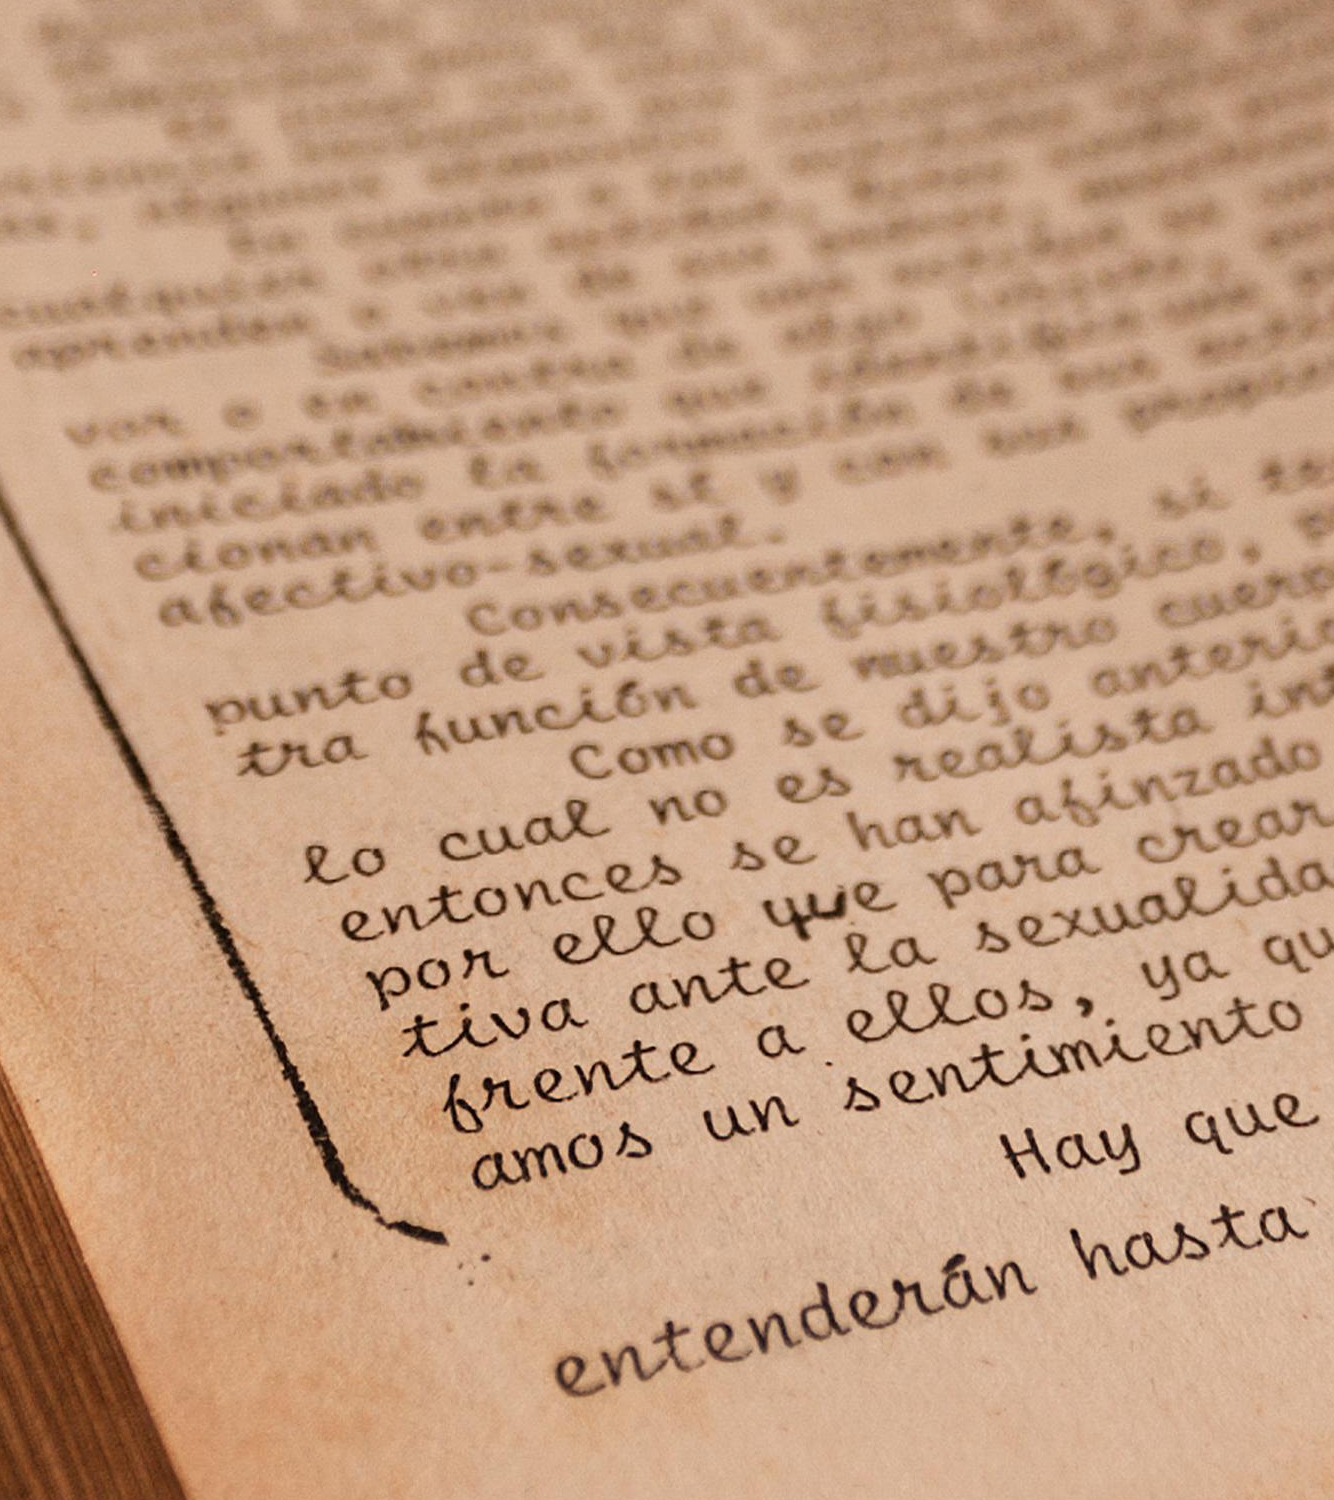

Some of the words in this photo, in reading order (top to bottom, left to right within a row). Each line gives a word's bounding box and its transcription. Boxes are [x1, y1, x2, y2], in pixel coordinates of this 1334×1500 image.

[203, 670, 413, 737] punto
[458, 648, 543, 687] de
[577, 617, 778, 669] vista
[237, 734, 368, 779] tra
[413, 680, 697, 757] función
[732, 660, 817, 699] de
[851, 619, 1116, 681] nuestro
[568, 733, 736, 781] Como
[783, 712, 863, 749] se
[899, 685, 1050, 728] dijo
[303, 843, 387, 887] lo
[437, 798, 611, 863] cual
[648, 788, 729, 827] no
[775, 766, 852, 805] es
[892, 708, 1211, 783] realista
[339, 854, 684, 944] entonces
[730, 835, 816, 873] se
[845, 809, 980, 852] han
[1014, 737, 1321, 827] afinzado
[364, 949, 511, 1013] por
[552, 906, 717, 967] ello
[761, 881, 897, 943] que
[926, 847, 1101, 911] para
[401, 998, 589, 1060] tiva
[628, 956, 810, 1017] ante
[844, 933, 938, 976] la
[441, 1040, 716, 1136] frente
[756, 1025, 807, 1061] a
[845, 979, 1095, 1045] ellos,
[1139, 951, 1230, 1003] ya
[471, 1122, 654, 1194] amos
[701, 1096, 801, 1144] un
[842, 997, 1303, 1114] sentimiento
[998, 1123, 1142, 1181] Hay
[1183, 1093, 1321, 1157] que
[552, 1253, 1039, 1400] entenderán
[1068, 1204, 1310, 1282] hasta
